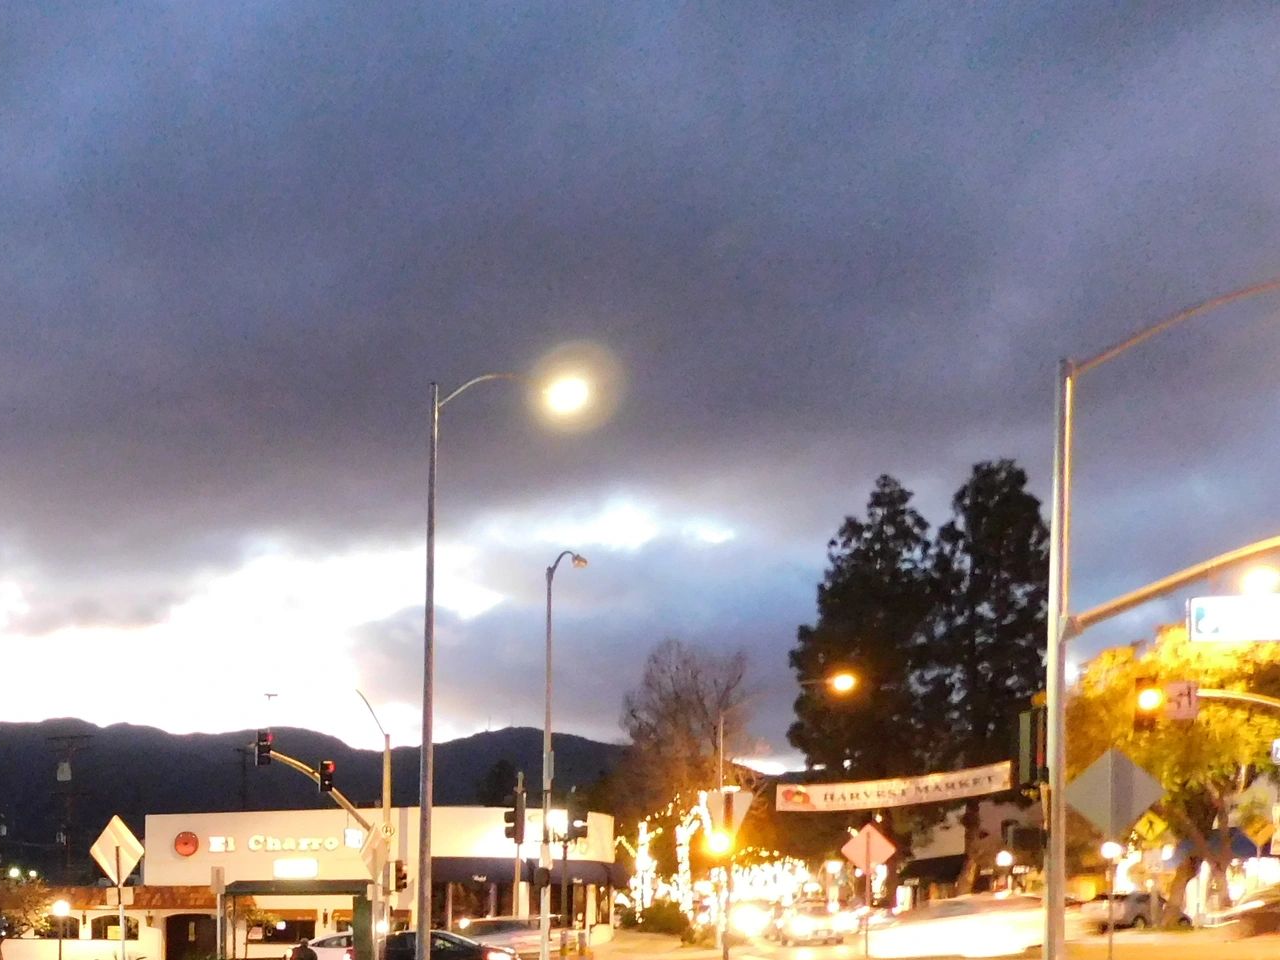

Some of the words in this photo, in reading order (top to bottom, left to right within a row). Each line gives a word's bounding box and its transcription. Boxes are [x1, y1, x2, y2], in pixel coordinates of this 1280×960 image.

[823, 788, 907, 802] HARVEST
[914, 775, 994, 794] MARKET
[208, 836, 237, 853] El
[248, 834, 339, 852] Charro
